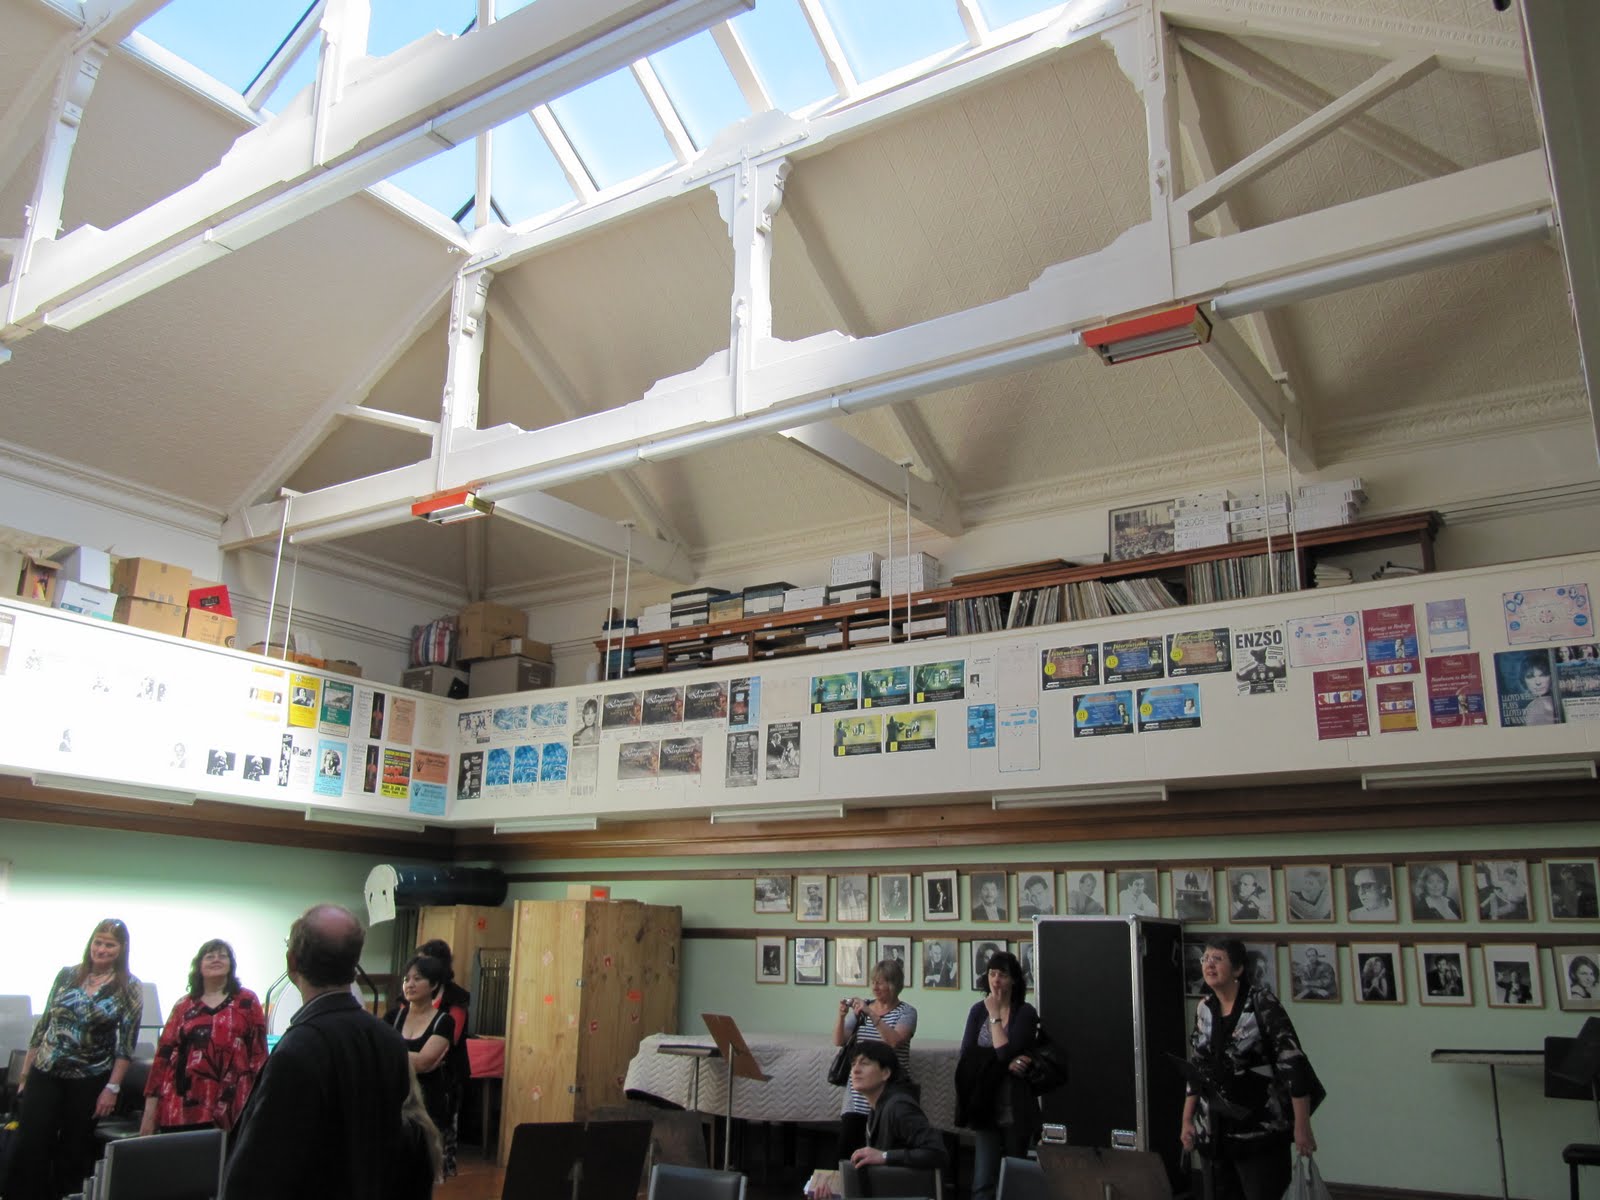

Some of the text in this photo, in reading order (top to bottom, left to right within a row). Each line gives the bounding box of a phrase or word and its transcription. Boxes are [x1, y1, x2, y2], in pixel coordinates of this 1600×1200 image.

[1235, 629, 1282, 649] ENZSO
[1113, 640, 1148, 650] International
[1501, 694, 1520, 702] LLOYD
